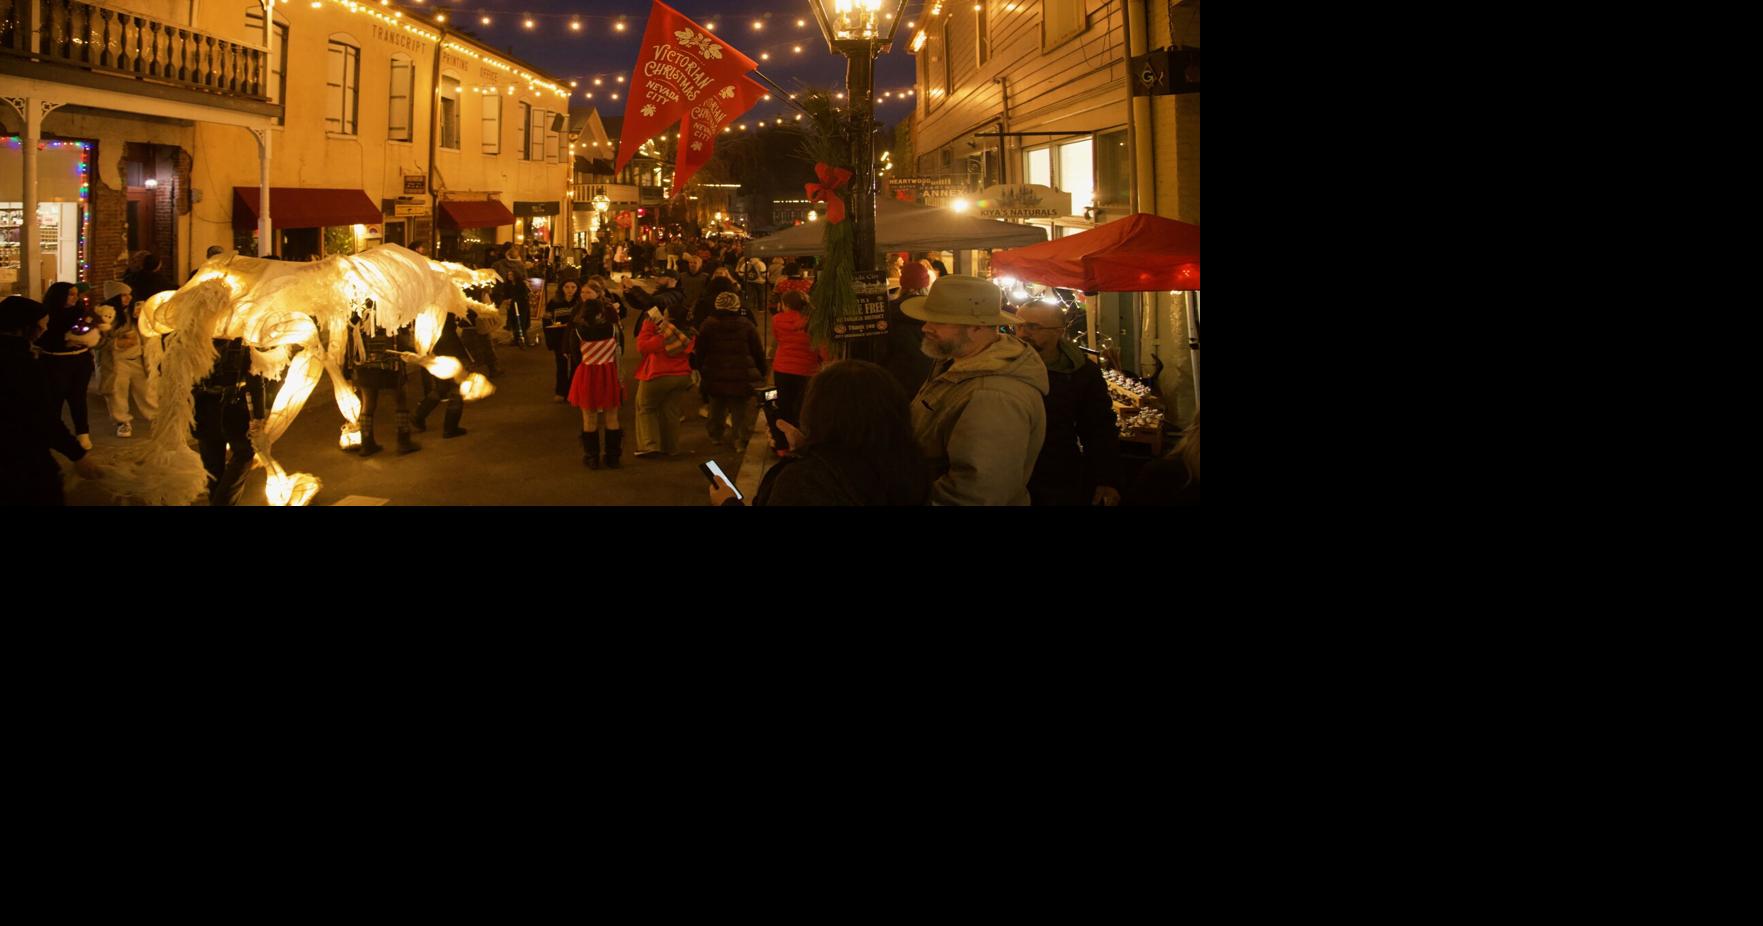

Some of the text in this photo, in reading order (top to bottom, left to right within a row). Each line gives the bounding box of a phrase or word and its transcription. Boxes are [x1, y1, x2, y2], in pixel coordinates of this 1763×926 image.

[372, 25, 425, 54] TRANSCRIPT
[653, 44, 715, 90] VICTORIAN
[644, 61, 700, 101] CHRISTMAS
[645, 80, 680, 103] NEVADA
[646, 91, 669, 105] CITY
[923, 189, 967, 198] ANNEX
[981, 207, 1057, 217] KIYA'S NATURALS
[864, 302, 885, 314] FREE
